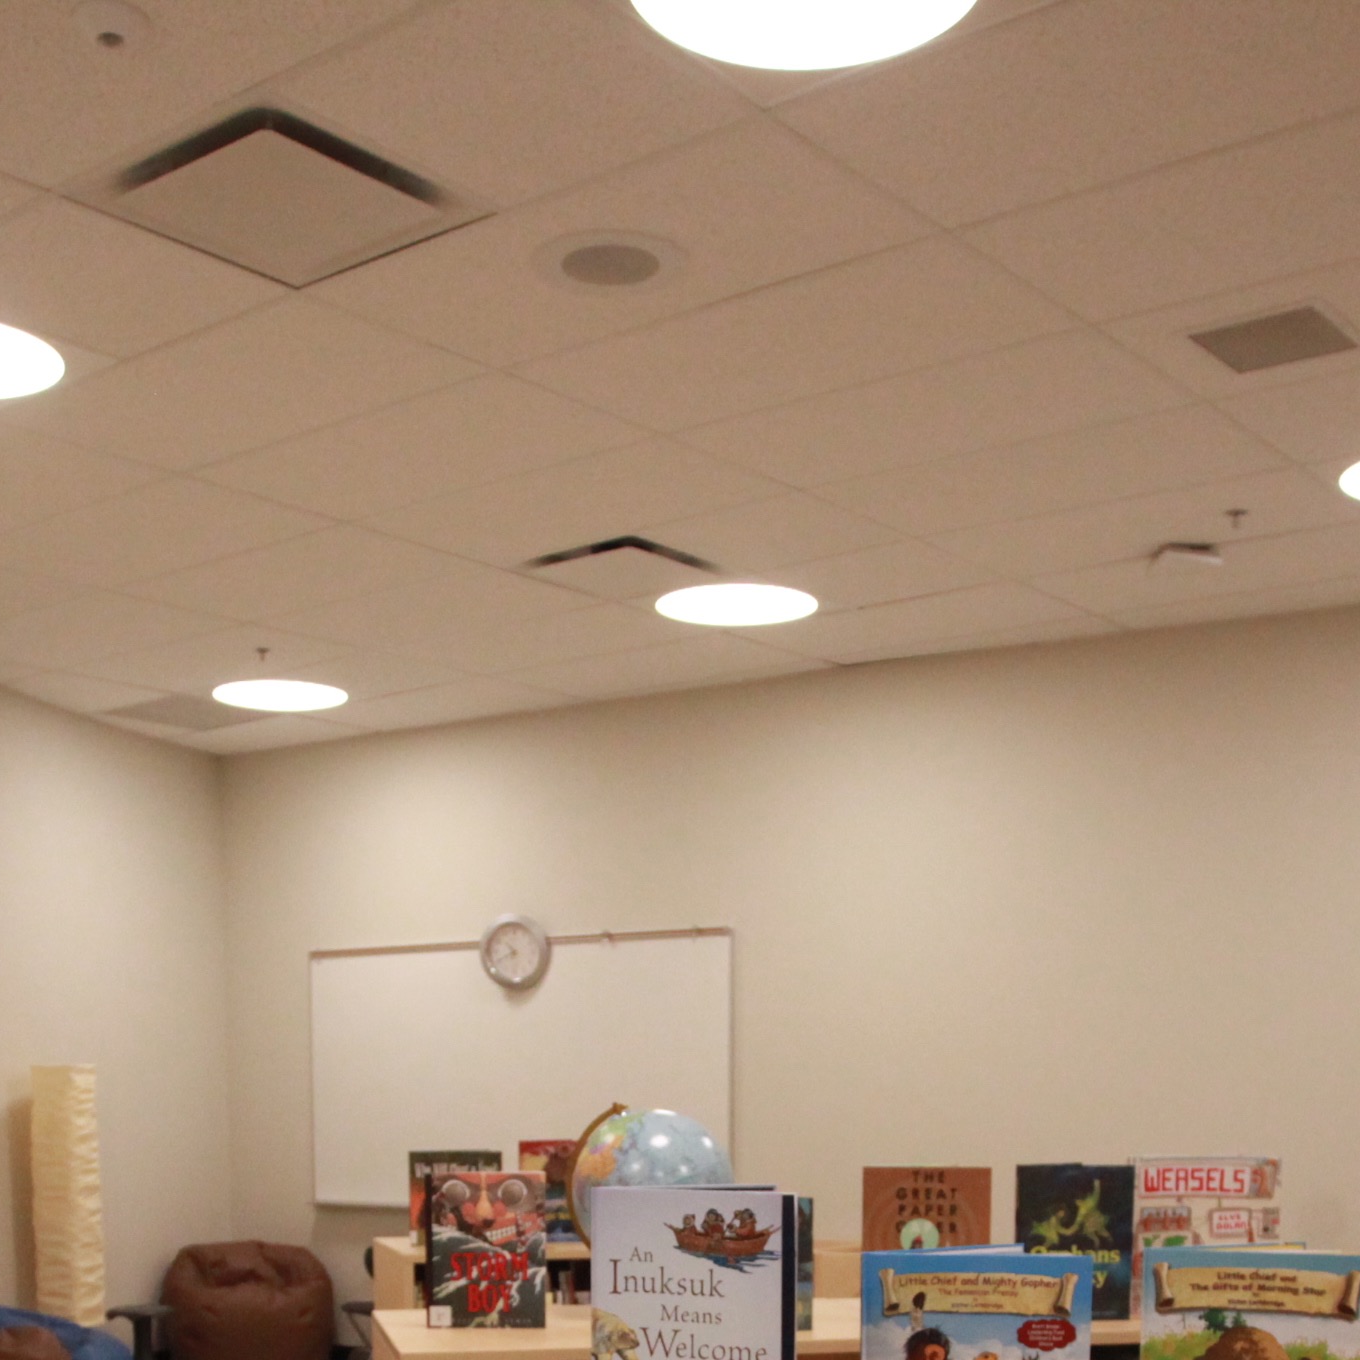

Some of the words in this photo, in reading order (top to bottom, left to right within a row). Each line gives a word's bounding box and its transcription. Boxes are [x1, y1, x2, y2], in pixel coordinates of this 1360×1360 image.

[912, 1170, 945, 1183] THE
[1144, 1166, 1245, 1193] WEASELS
[895, 1187, 958, 1200] GREAT
[897, 1203, 958, 1217] PAPER
[629, 1245, 654, 1263] An
[450, 1252, 529, 1281] STORM
[609, 1259, 725, 1298] Inuksuk
[898, 1276, 927, 1288] Little
[930, 1275, 957, 1287] Chief
[960, 1275, 980, 1287] and
[982, 1275, 1017, 1289] Mighty
[1020, 1277, 1059, 1290] Gopher
[1217, 1271, 1246, 1281] Little
[1249, 1271, 1277, 1282] Chief
[1279, 1274, 1297, 1283] and
[1190, 1283, 1209, 1291] The
[1212, 1283, 1240, 1292] Gifts
[1242, 1283, 1253, 1292] of
[1256, 1284, 1300, 1295] Morning
[1302, 1286, 1327, 1296] Star
[467, 1284, 512, 1313] BOY
[660, 1304, 723, 1325] Means
